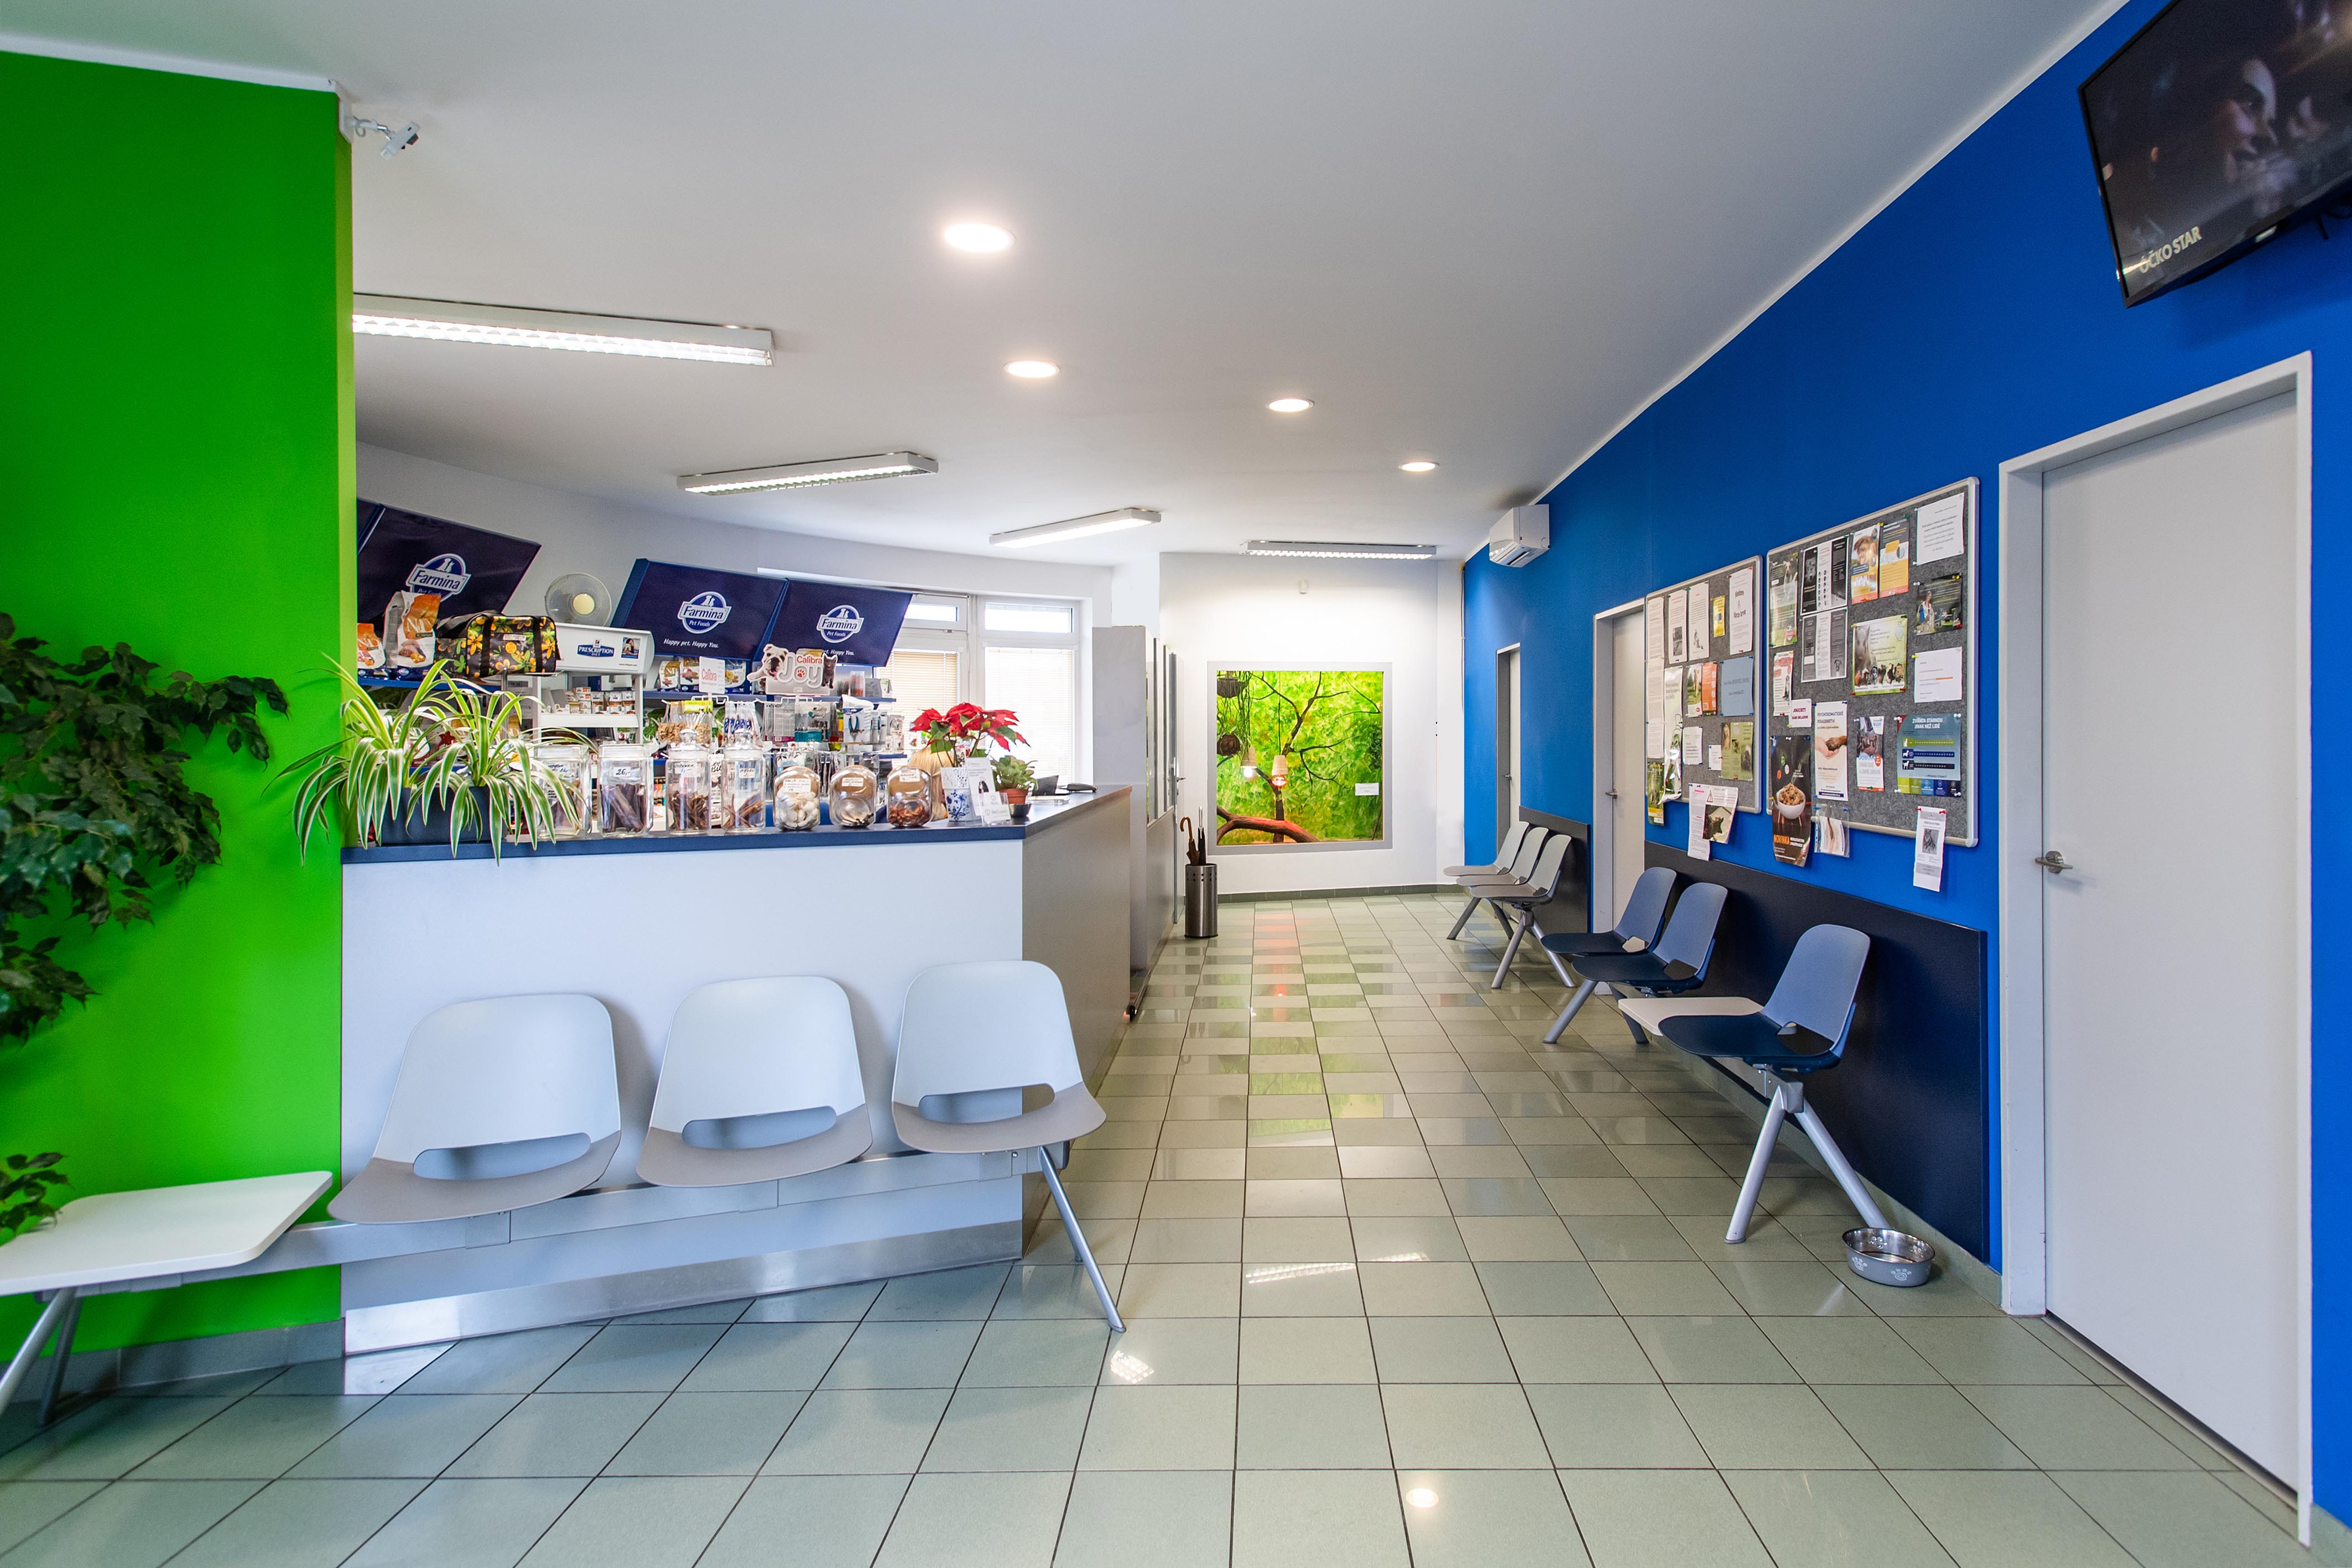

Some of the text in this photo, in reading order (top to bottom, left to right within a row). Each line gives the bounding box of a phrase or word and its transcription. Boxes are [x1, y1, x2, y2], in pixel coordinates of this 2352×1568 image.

[2172, 226, 2202, 254] STAR
[414, 570, 460, 590] Farmina
[684, 606, 724, 619] Farmina
[821, 619, 857, 629] Farmina
[579, 646, 614, 654] PRESCRIPTION
[702, 668, 717, 681] Calibra
[777, 654, 823, 687] Joy
[1773, 835, 1790, 845] NOVINKA
